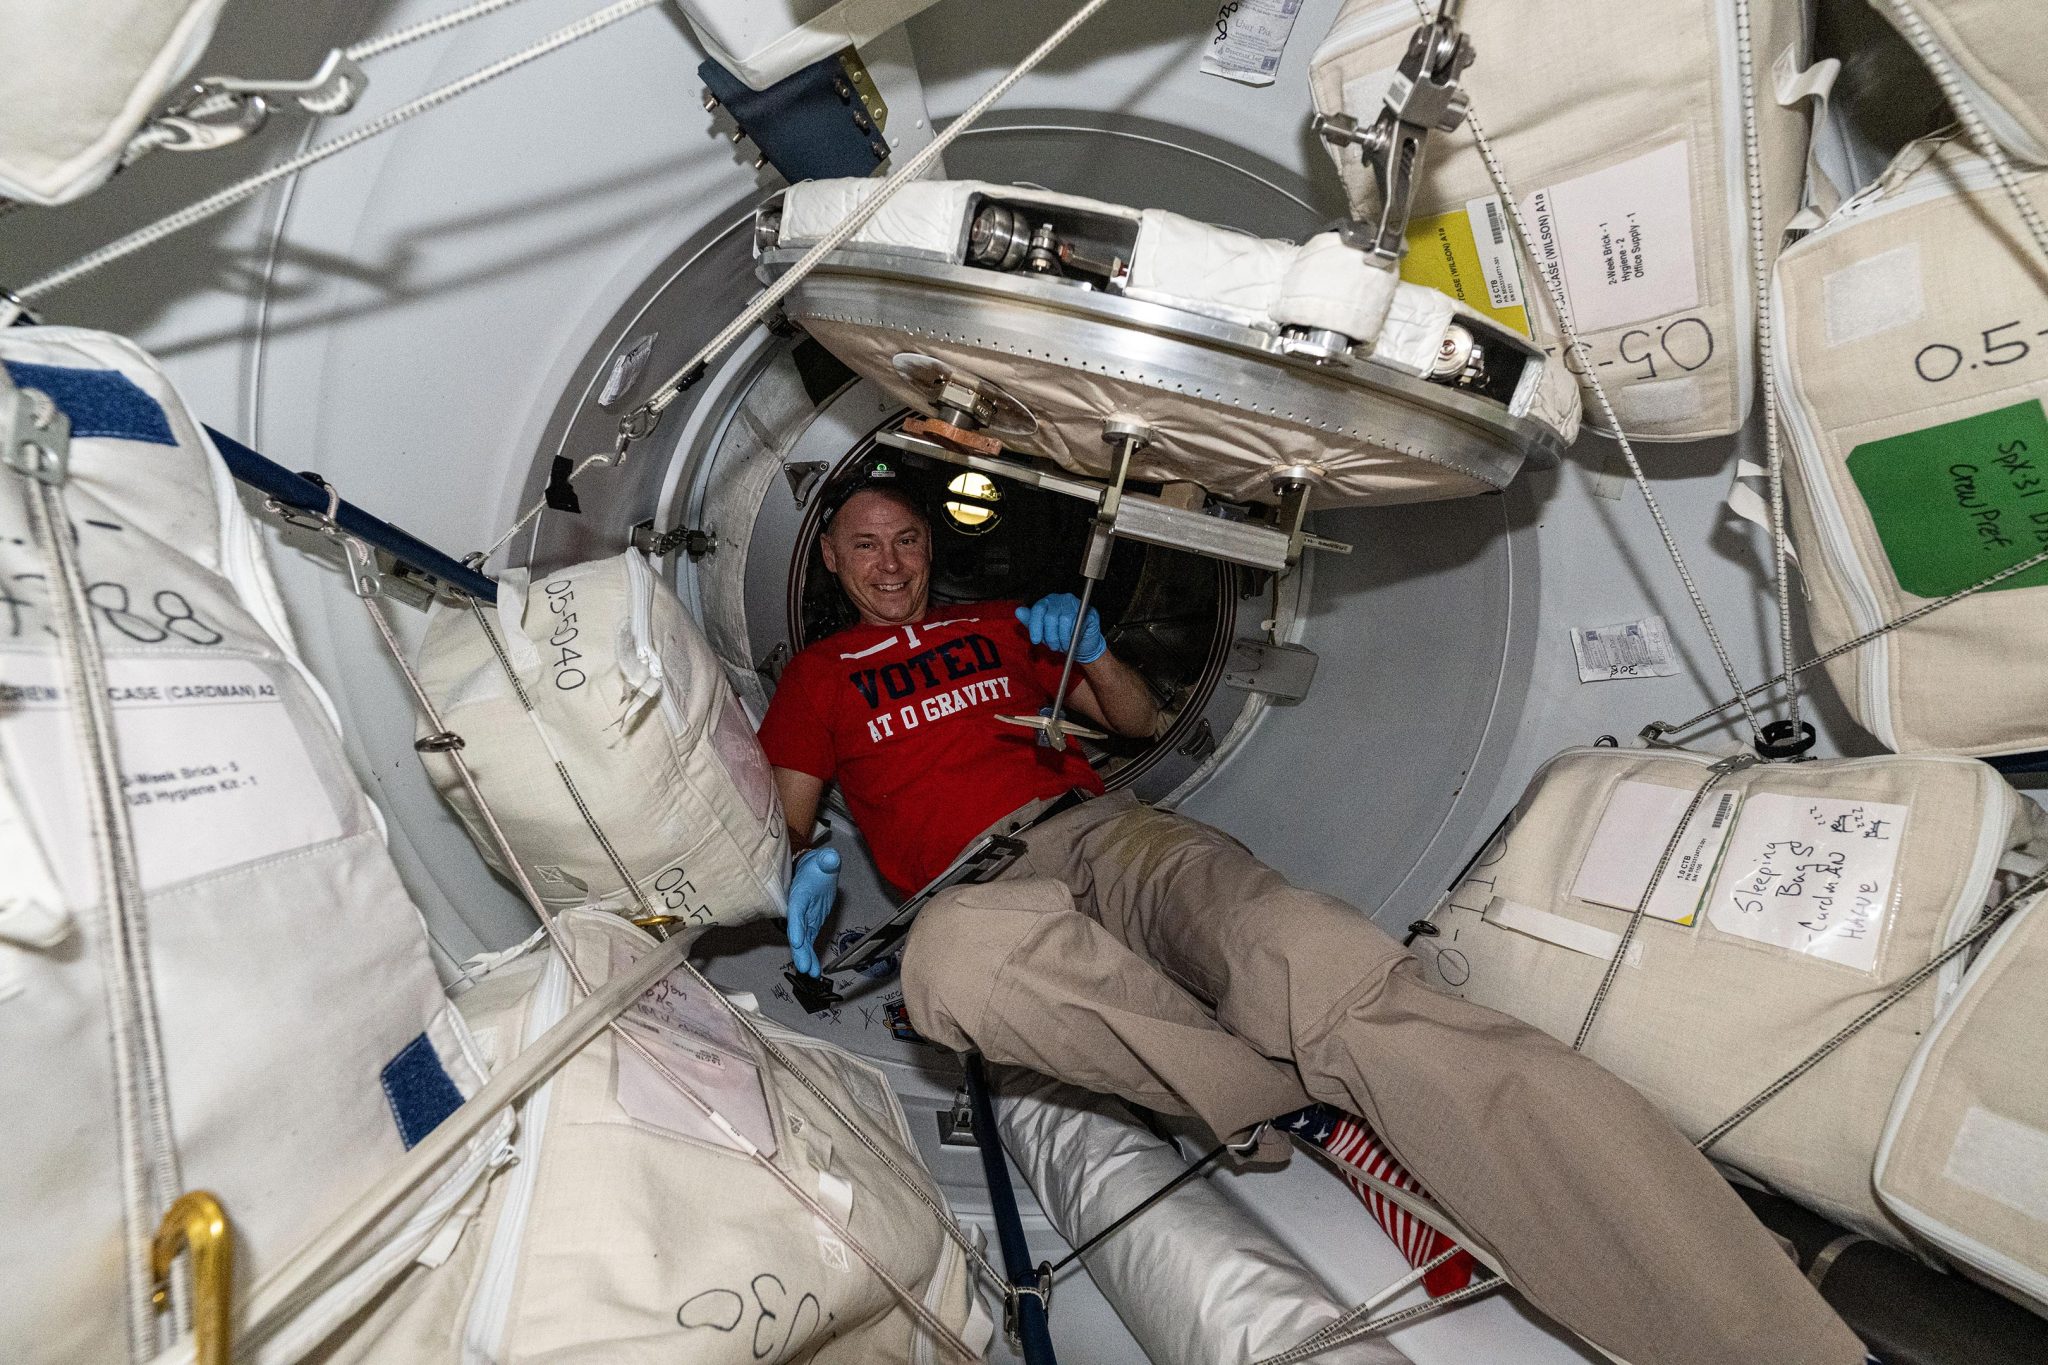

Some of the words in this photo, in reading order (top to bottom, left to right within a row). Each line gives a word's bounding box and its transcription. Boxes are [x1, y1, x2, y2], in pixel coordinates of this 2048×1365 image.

[1535, 193, 1546, 213] A1a
[1538, 213, 1556, 261] (WILSON)
[1600, 234, 1613, 258] Brick
[1630, 224, 1643, 252] Supply
[1443, 242, 1459, 277] (WILSON)
[1604, 259, 1617, 285] 2-Week
[1620, 250, 1632, 282] Hygiene
[1632, 253, 1645, 278] Office
[1491, 279, 1500, 294] CTB
[1495, 292, 1503, 304] 0.5
[545, 580, 586, 690] 0.5-5040
[902, 625, 921, 650] I
[849, 633, 1002, 710] VOTED
[165, 684, 256, 699] (CARDMAN)
[259, 684, 276, 697] A2
[867, 713, 894, 743] AT
[921, 677, 1011, 722] GRAVITY
[181, 764, 218, 778] Brick
[156, 784, 217, 802] Hygiene
[221, 778, 240, 790] Kit
[1677, 869, 1686, 880] 1.0
[1681, 855, 1691, 869] CTB
[1733, 841, 1793, 913] Sleeping
[655, 868, 719, 926] 0.5-5
